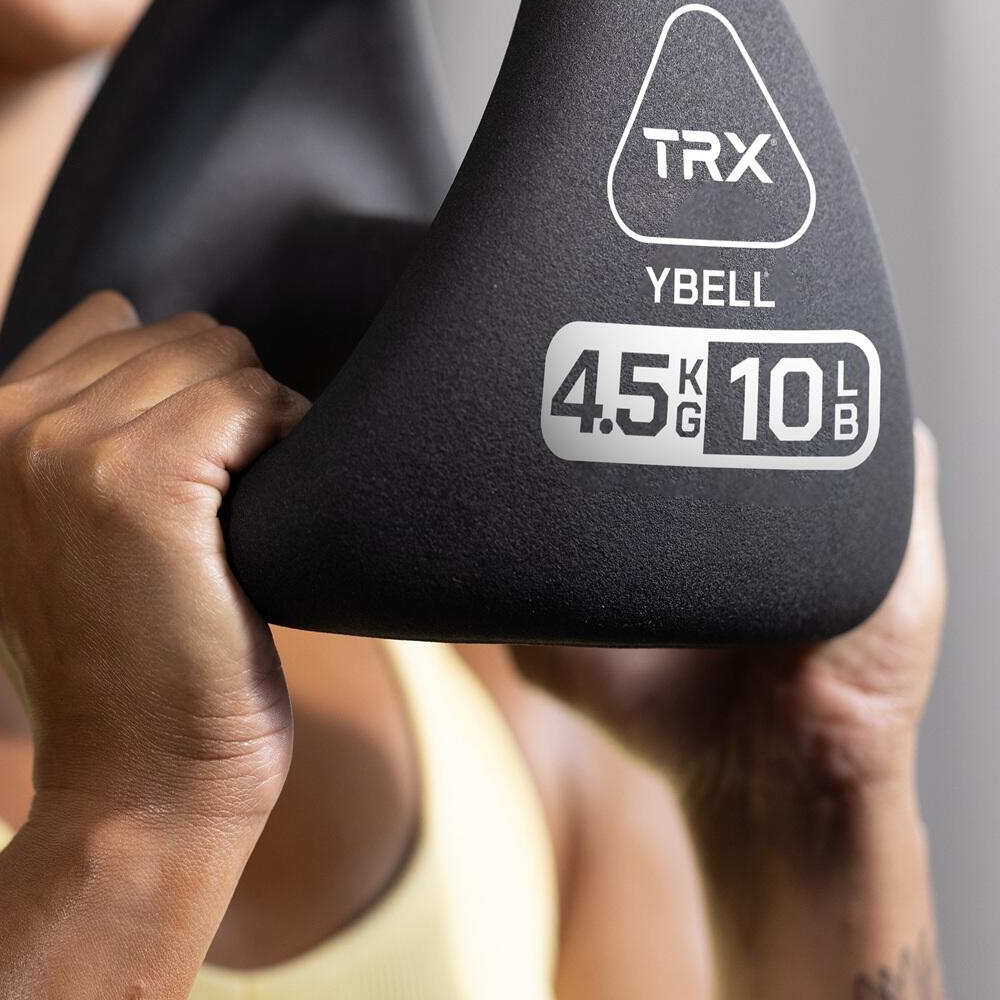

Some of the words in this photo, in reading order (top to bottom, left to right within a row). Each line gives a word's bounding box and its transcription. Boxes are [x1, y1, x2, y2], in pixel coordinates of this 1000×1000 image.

[643, 127, 774, 184] TRX
[645, 266, 776, 308] YBELL
[550, 349, 671, 438] 4.5
[730, 357, 824, 442] 10
